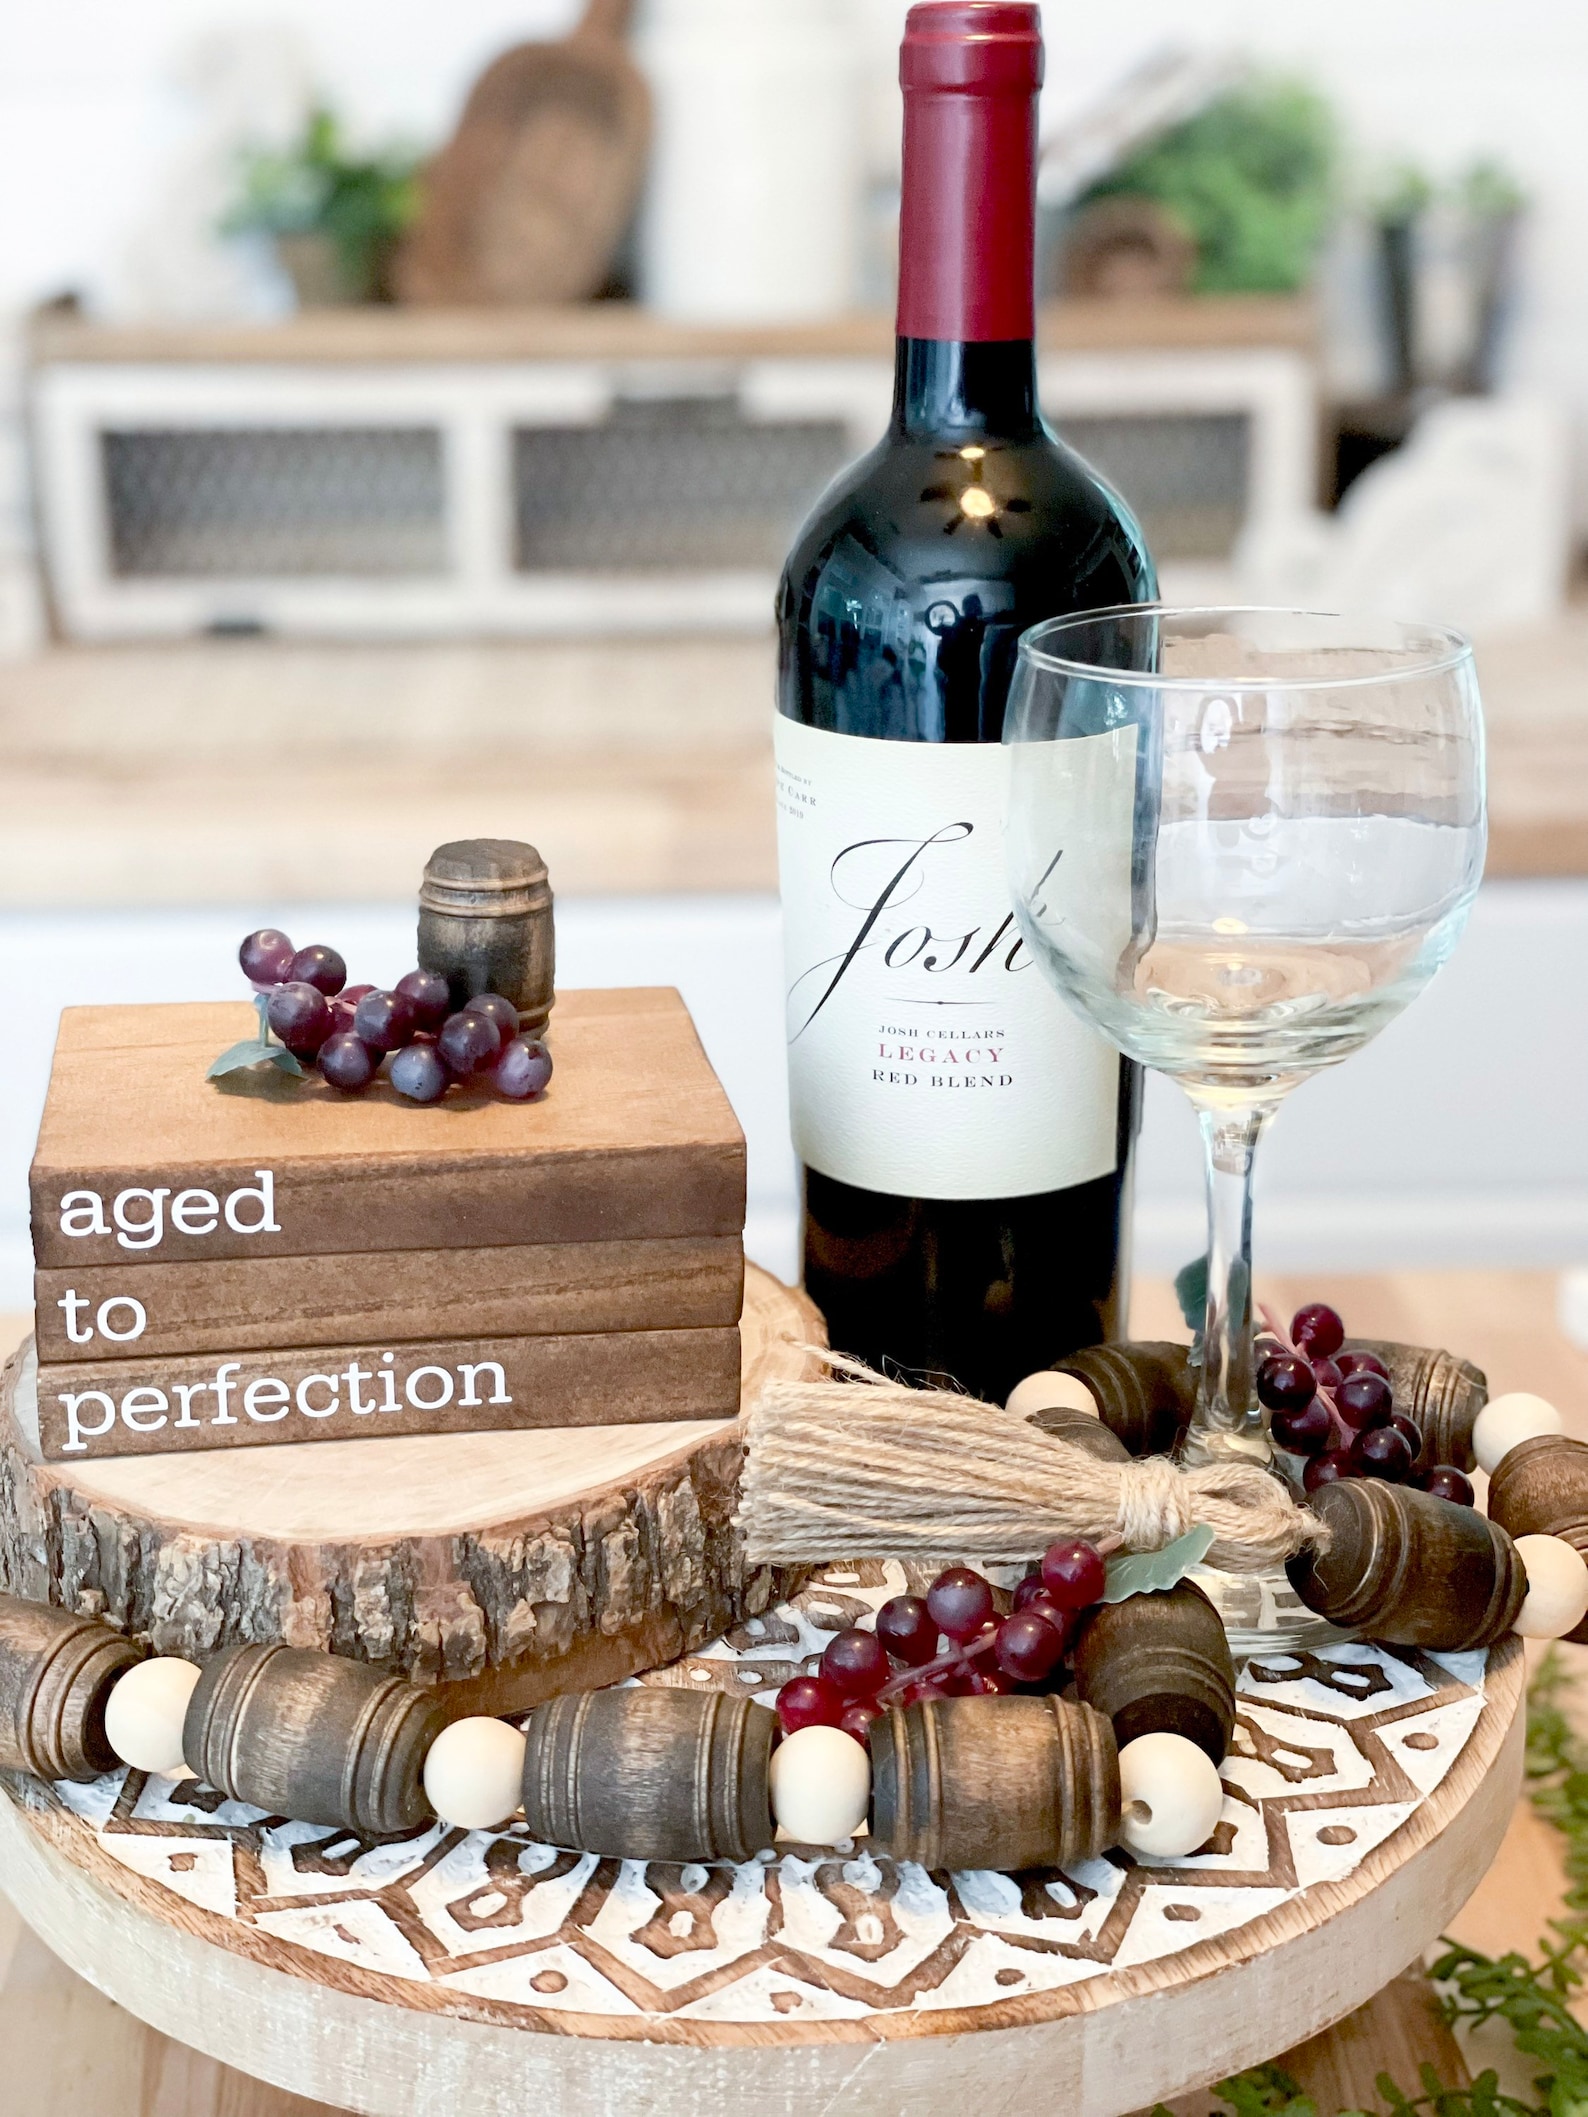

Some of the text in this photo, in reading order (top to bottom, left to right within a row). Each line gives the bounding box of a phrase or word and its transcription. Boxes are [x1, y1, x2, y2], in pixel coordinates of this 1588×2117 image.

[788, 785, 817, 807] CARR
[785, 821, 1065, 1045] Josh
[879, 1025, 1006, 1040] JOSH CELLARS
[879, 1043, 1004, 1064] LEGACY
[872, 1069, 1014, 1088] RED BLEND
[59, 1170, 281, 1250] aged
[57, 1289, 147, 1343] to
[58, 1352, 513, 1452] perfection
